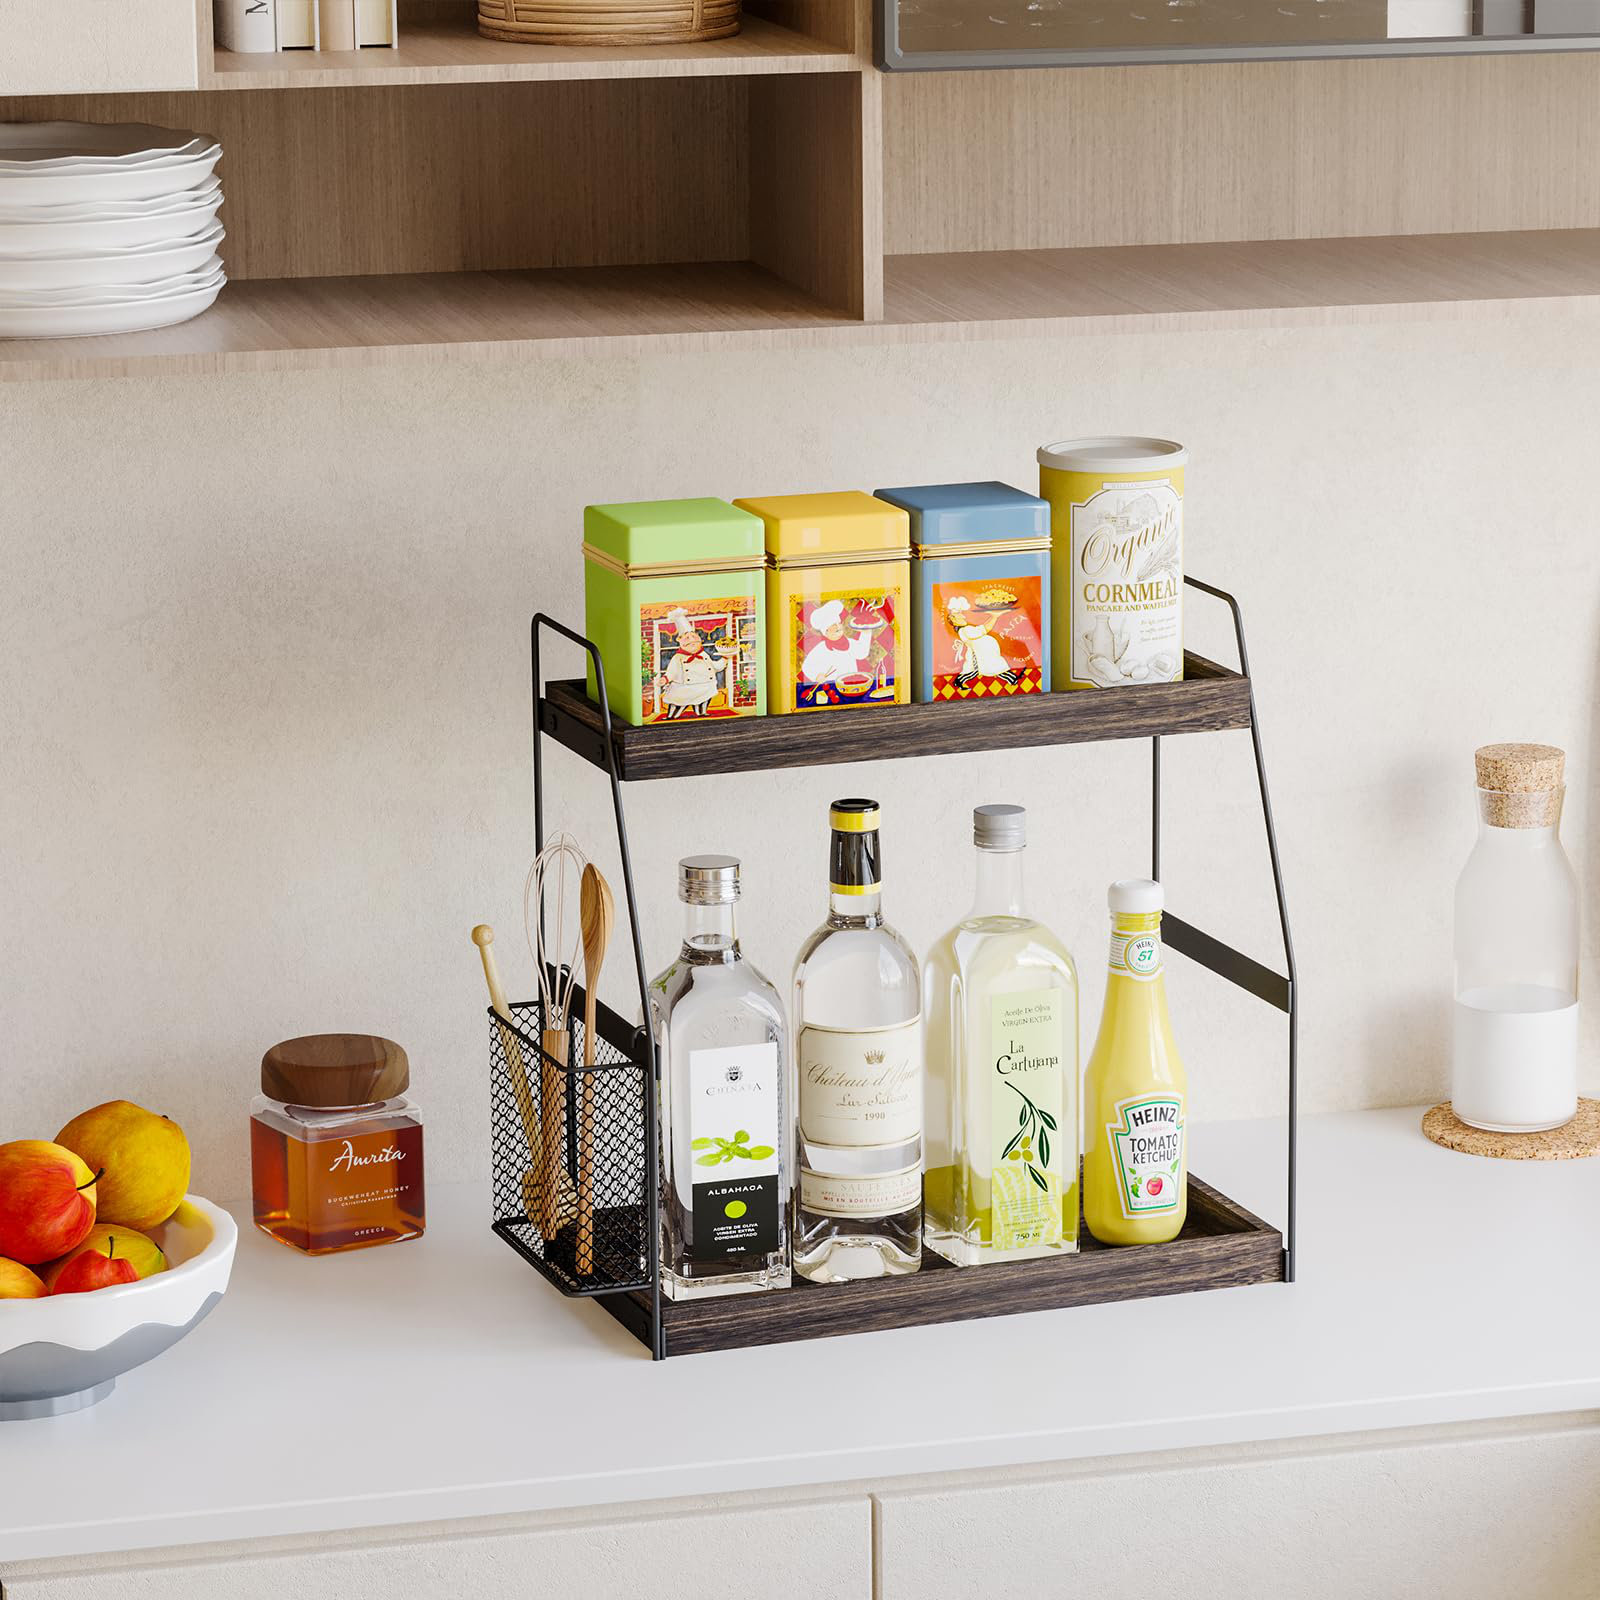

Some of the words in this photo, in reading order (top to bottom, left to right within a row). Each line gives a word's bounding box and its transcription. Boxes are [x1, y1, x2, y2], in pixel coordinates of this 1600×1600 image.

[1080, 504, 1176, 576] Organic
[1083, 578, 1178, 604] CORNMEAL
[1086, 604, 1123, 612] PANCAKE
[1124, 604, 1141, 612] AND
[1142, 602, 1167, 611] WAFFLE
[1136, 941, 1154, 949] HEINZ
[1137, 949, 1154, 961] 57
[1002, 1018, 1028, 1027] VIRGEN
[1029, 1015, 1052, 1024] EXTRA
[1010, 1040, 1024, 1054] La
[1132, 1106, 1176, 1127] HEINZ
[1129, 1133, 1178, 1152] TOMATO
[329, 1140, 407, 1173] Amrita
[1133, 1148, 1177, 1164] KETCHUP
[384, 1185, 410, 1193] HONEY
[708, 1184, 763, 1196] ALBAHACA
[354, 1226, 385, 1236] GREECE
